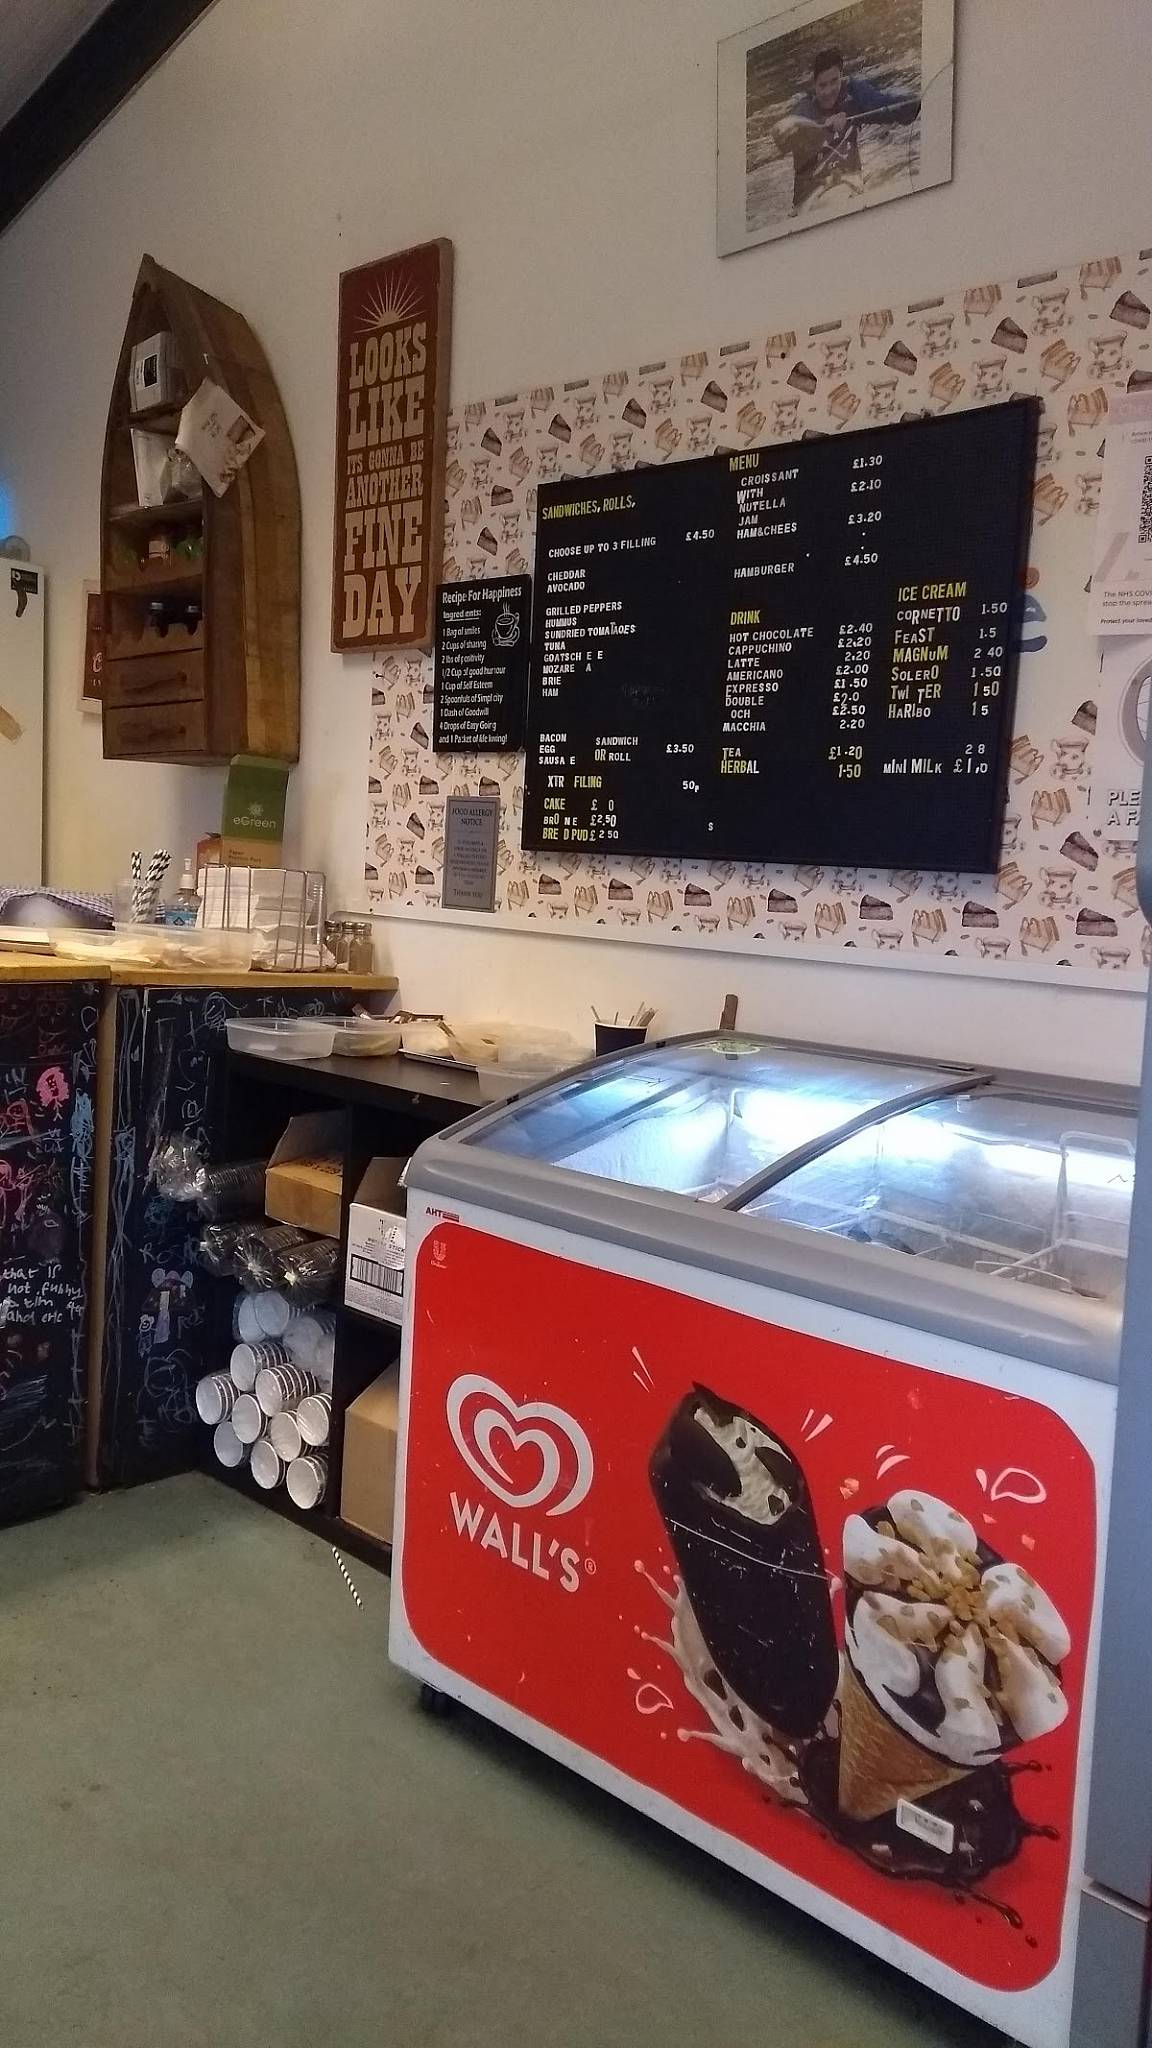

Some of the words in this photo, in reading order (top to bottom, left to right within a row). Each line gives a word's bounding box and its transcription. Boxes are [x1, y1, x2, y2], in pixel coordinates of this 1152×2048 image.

[349, 321, 427, 389] LOOKS
[347, 374, 425, 450] LIKE
[346, 452, 363, 475] ITS
[367, 443, 404, 470] GONNA
[410, 438, 424, 461] BE
[729, 453, 760, 473] MENU
[741, 468, 800, 487] CROISSANT
[852, 455, 882, 470] £1.30
[345, 463, 423, 509] ANOTHER
[736, 487, 764, 505] WITH
[850, 478, 881, 493] £2.10
[542, 499, 601, 521] SANDWICHES,
[603, 495, 637, 512] ROLLS,
[738, 497, 787, 514] NUTELLA
[737, 514, 759, 527] JAM
[848, 511, 882, 526] £3.20
[343, 499, 423, 572] FINE
[736, 522, 798, 541] HAM&CHEES
[548, 545, 582, 558] CHOOSE
[583, 544, 596, 555] UP
[597, 542, 610, 554] TO
[612, 541, 620, 551] 3
[620, 537, 657, 552] FILLING
[685, 529, 715, 543] £4.50
[734, 562, 795, 580] HAMBURGER
[844, 552, 878, 567] £4.50
[547, 569, 587, 583] CHEDDAR
[442, 591, 468, 606] Recipe
[468, 589, 482, 602] For
[482, 585, 523, 603] Happiness
[546, 581, 586, 595] AVOCADO
[898, 586, 918, 603] ICE
[921, 581, 967, 601] CREAM
[342, 565, 421, 638] DAY
[545, 602, 581, 616] GRILLED
[582, 599, 623, 614] PEPPERS
[981, 602, 1007, 615] 1.50
[544, 617, 577, 629] HUMMUS
[730, 609, 761, 626] DRINK
[446, 627, 458, 639] Bag
[544, 628, 586, 640] SUNDRIED
[729, 632, 750, 644] HOT
[752, 627, 815, 642] CHOCOLATE
[839, 622, 873, 636] £2.40
[979, 627, 997, 640] 1.5
[441, 641, 446, 651] 2
[446, 640, 460, 652] Cups
[544, 641, 566, 652] TUNA
[728, 642, 793, 657] CAPPUCHINO
[441, 655, 446, 664] 2
[727, 657, 761, 669] LATTE
[844, 650, 871, 662] 2.20
[542, 664, 576, 674] MOZARE
[726, 669, 784, 683] AMERICANO
[835, 664, 869, 676] £2.00
[445, 681, 457, 693] Cup
[542, 676, 562, 686] BRIE
[725, 682, 779, 698] EXPRESSO
[834, 677, 869, 690] £1.50
[440, 695, 445, 704] 2
[542, 688, 559, 698] HAM
[725, 695, 765, 707] DOUBLE
[730, 709, 752, 719] OCH
[832, 705, 866, 717] £2.50
[444, 721, 460, 733] Drops
[722, 721, 767, 733] MACCHIA
[840, 719, 866, 730] 2.20
[539, 733, 568, 743] BACON
[595, 736, 639, 746] SANDWICH
[539, 744, 556, 754] EGG
[594, 748, 606, 763] OR
[608, 751, 631, 763] ROLL
[666, 743, 695, 755] £3.50
[722, 747, 742, 760] TEA
[720, 760, 760, 774] HERBAL
[547, 775, 565, 789] XTR
[573, 775, 602, 789] FILING
[682, 780, 700, 793] 50p
[543, 798, 566, 811] CAKE
[233, 816, 278, 830] eGreen
[1107, 811, 1121, 826] A
[449, 1491, 582, 1593] WALL'S
